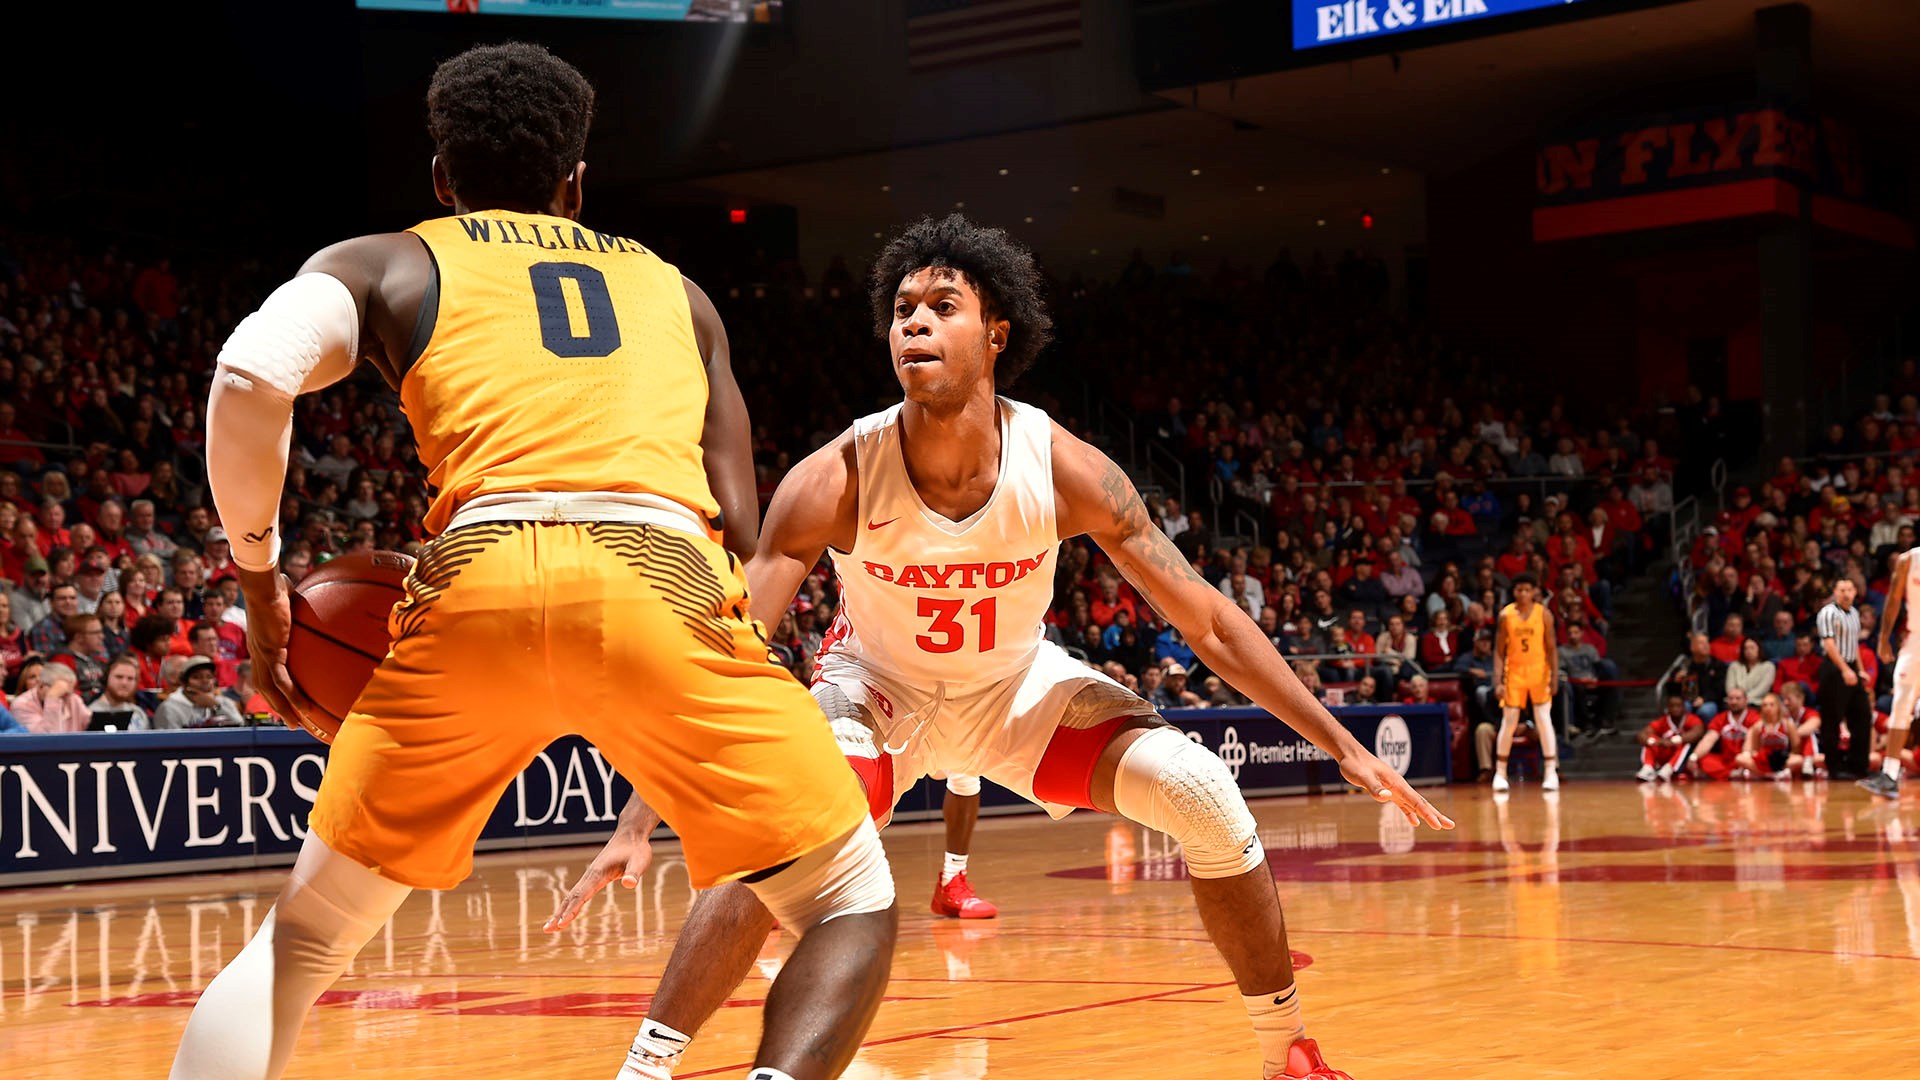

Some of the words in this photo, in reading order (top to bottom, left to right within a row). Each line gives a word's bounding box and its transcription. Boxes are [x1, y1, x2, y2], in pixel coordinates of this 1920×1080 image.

[1316, 0, 1380, 41] Elk
[1383, 0, 1417, 29] &
[528, 261, 622, 358] 0
[861, 548, 1049, 589] DAYTON
[916, 596, 997, 654] 31
[1521, 638, 1529, 652] 5
[1249, 740, 1295, 764] Premier
[1296, 740, 1334, 762] Heal
[0, 753, 326, 858] NIVERS
